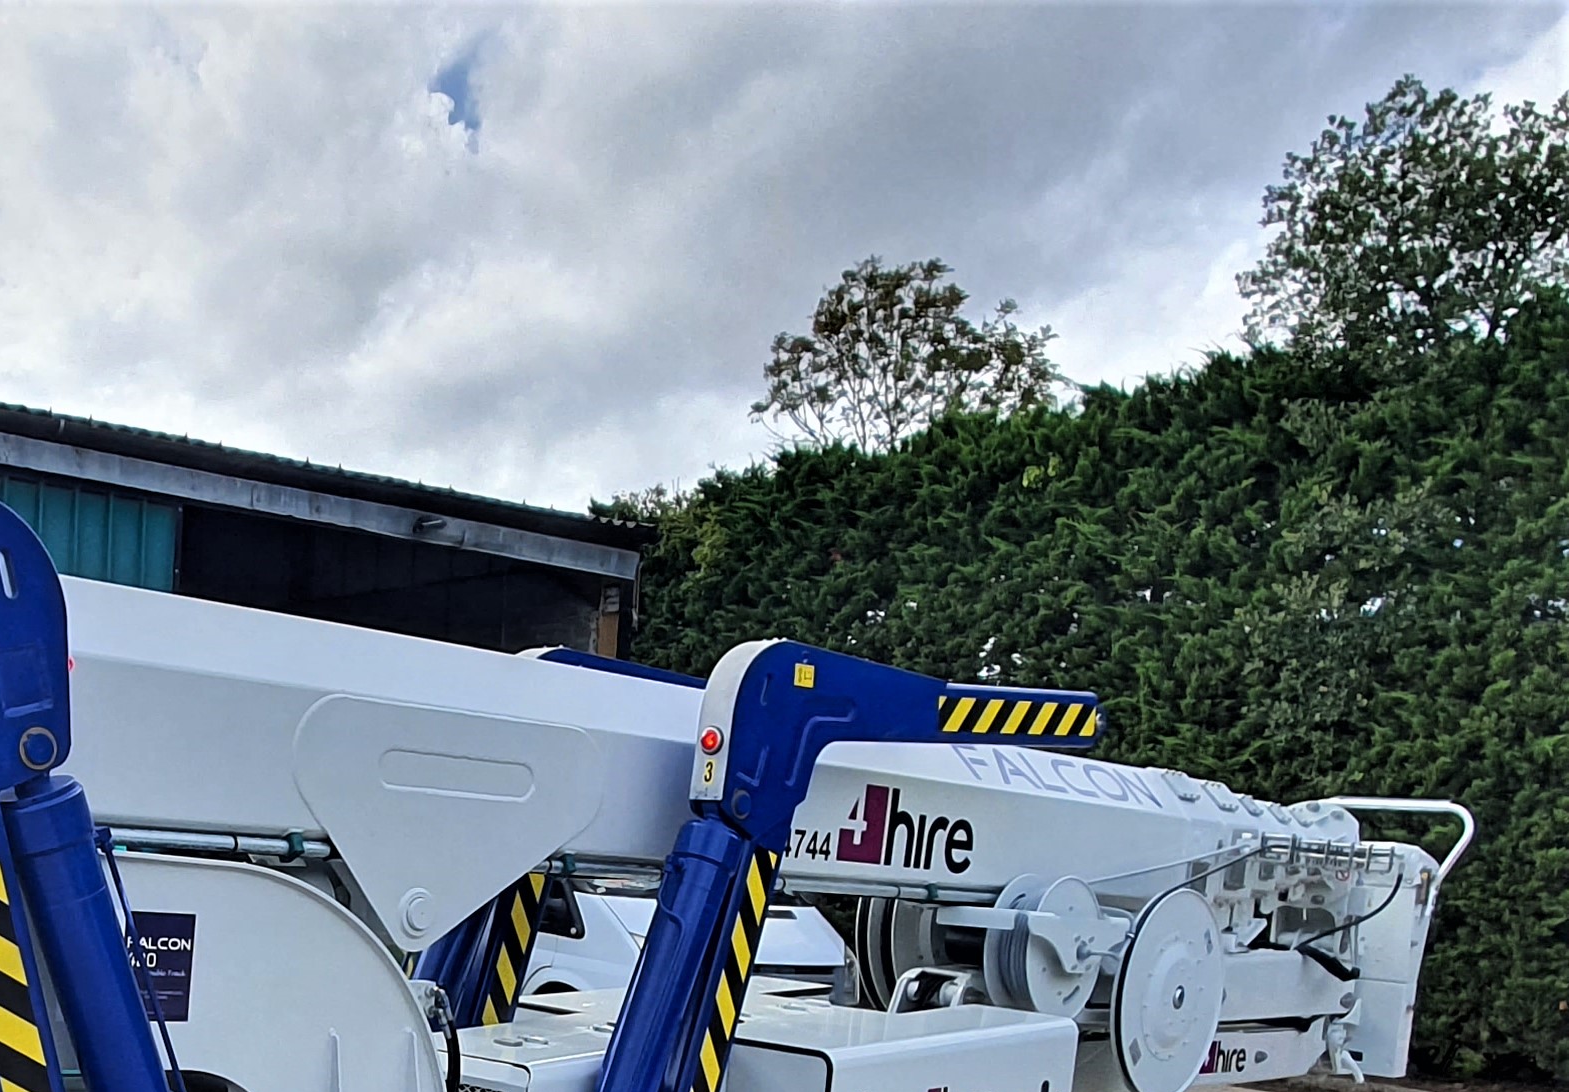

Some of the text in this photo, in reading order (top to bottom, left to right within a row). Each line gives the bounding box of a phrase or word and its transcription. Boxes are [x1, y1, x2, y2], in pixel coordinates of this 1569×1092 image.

[704, 761, 713, 782] 3
[951, 744, 1163, 808] FALCON
[836, 784, 974, 874] 4hire
